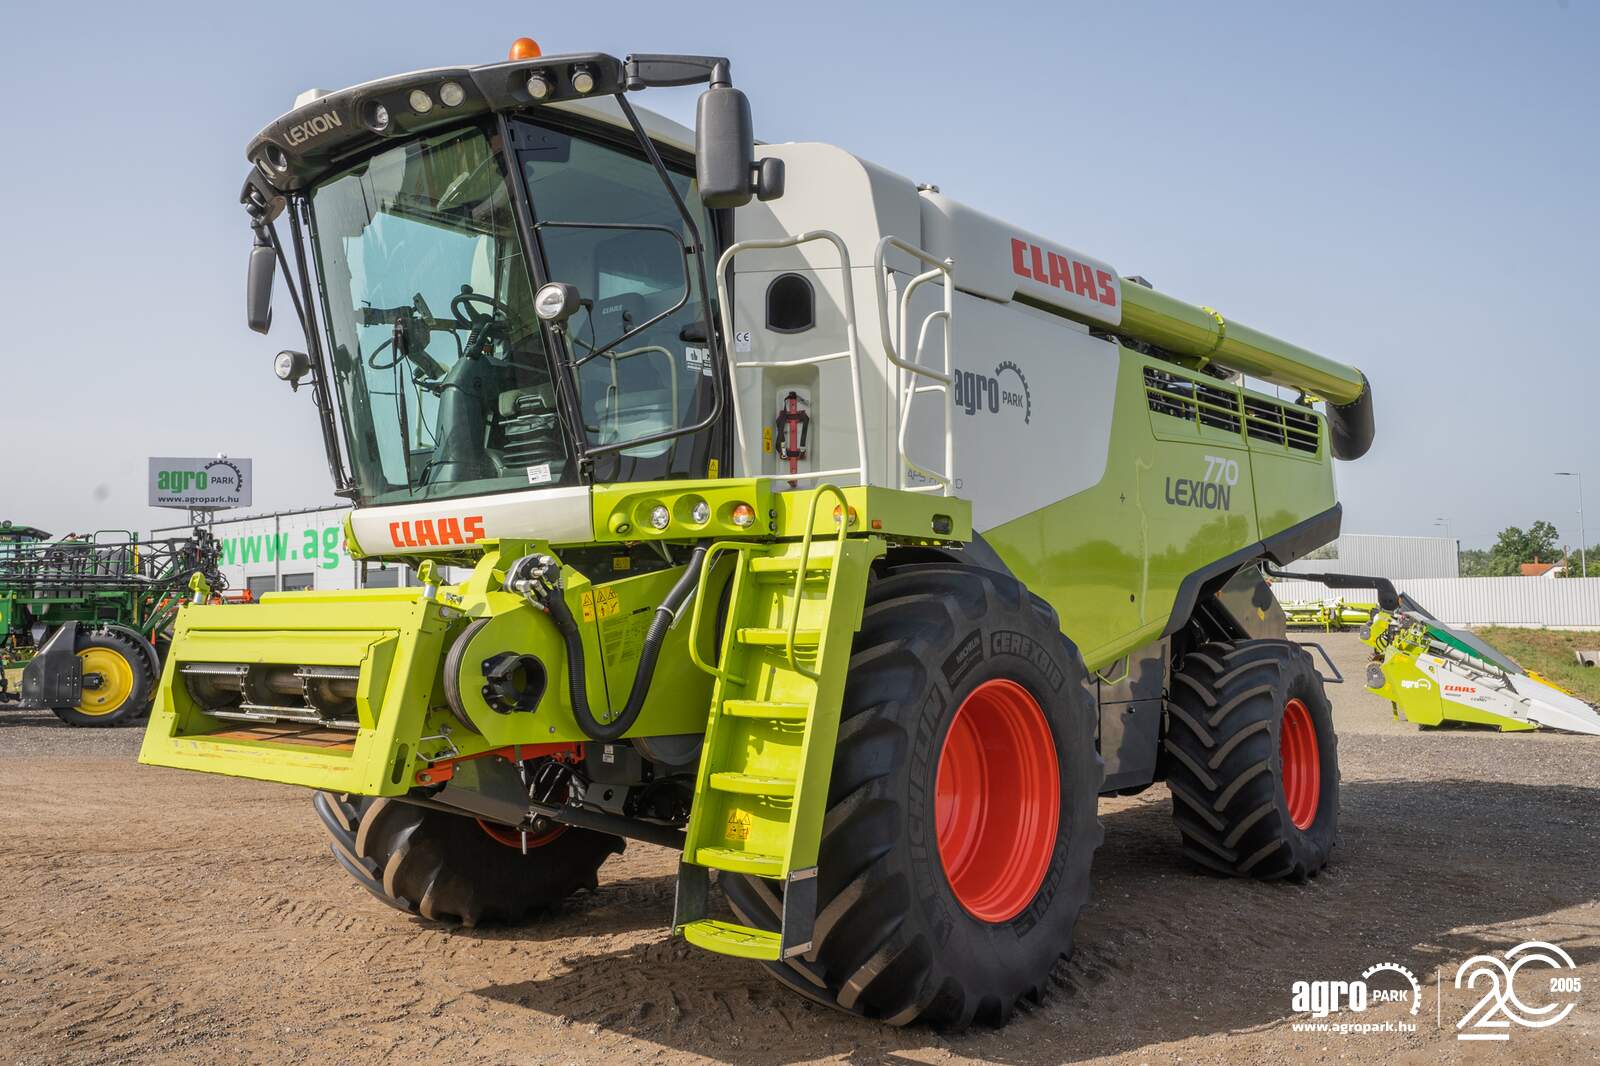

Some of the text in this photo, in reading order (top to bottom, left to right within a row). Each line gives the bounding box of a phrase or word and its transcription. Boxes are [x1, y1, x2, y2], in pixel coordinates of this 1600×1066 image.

[283, 110, 342, 147] LEXION
[1010, 237, 1117, 307] CLAAS
[954, 367, 1024, 416] agro PARK
[157, 470, 234, 493] agro PARK
[1203, 455, 1239, 486] 770
[157, 495, 240, 504] www.agropark.hu
[1164, 476, 1231, 511] LEXION
[389, 516, 486, 548] CLAAS
[1443, 684, 1477, 694] CLAAS
